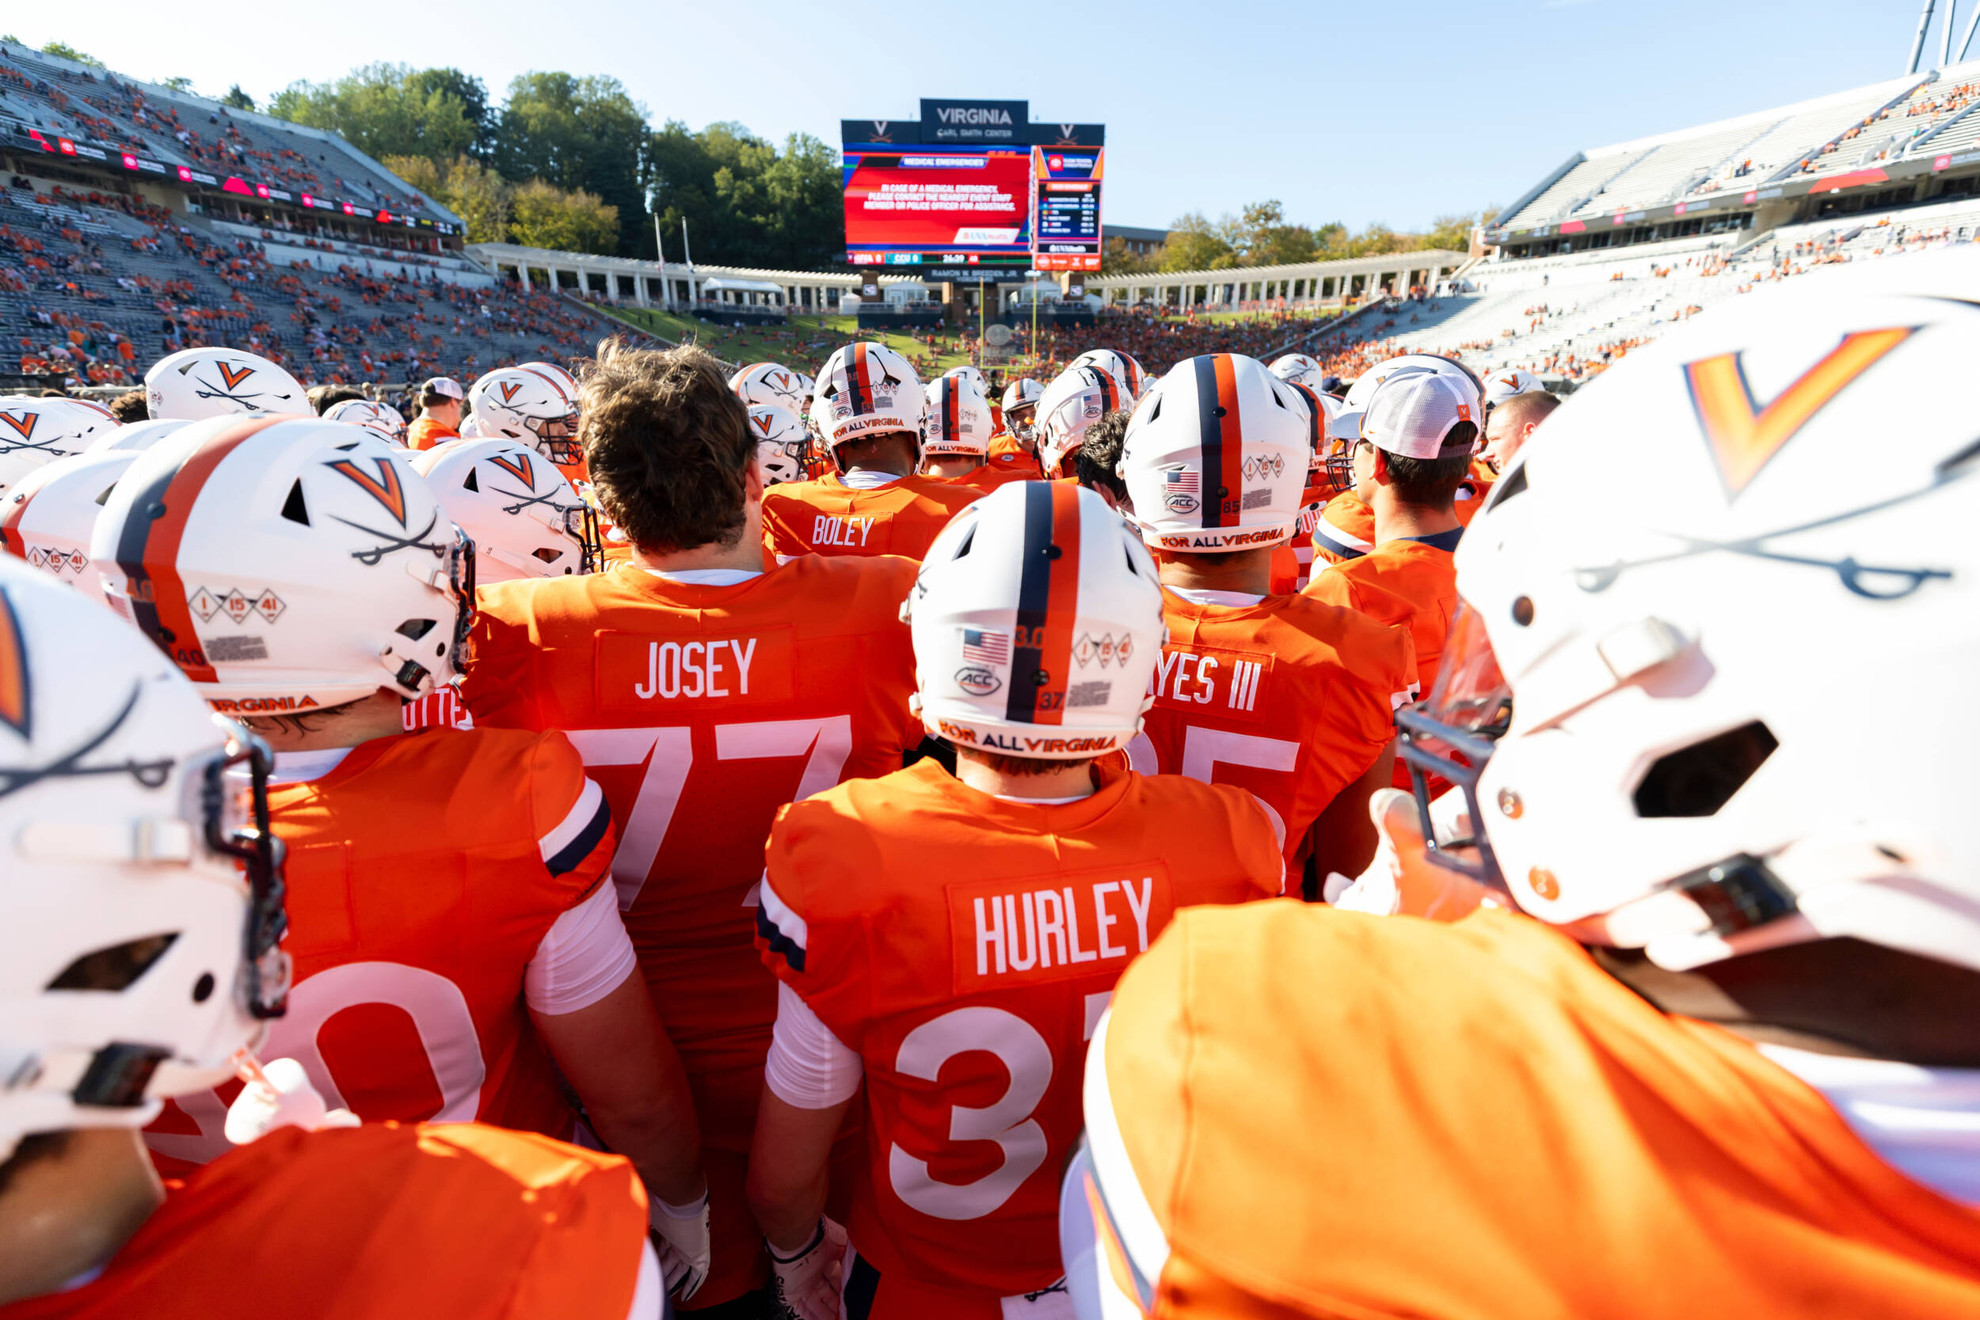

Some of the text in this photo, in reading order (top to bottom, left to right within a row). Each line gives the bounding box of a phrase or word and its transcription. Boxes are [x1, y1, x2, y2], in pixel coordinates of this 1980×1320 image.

[936, 108, 1013, 125] VIRGINIA
[936, 128, 1013, 138] CARL SMITH CENTER
[904, 157, 985, 167] MEDICAL EMERGENCIES
[868, 192, 894, 201] PLEASE
[894, 192, 925, 201] CONTACT
[925, 193, 939, 201] THE
[890, 184, 909, 193] CASE
[924, 184, 955, 193] MEDICAL
[863, 200, 895, 210] MEMBER
[906, 201, 931, 210] POLICE
[959, 202, 974, 211] FOR
[832, 417, 905, 439] FOR ALL VIRGINIA
[1222, 500, 1241, 514] 85
[811, 514, 876, 548] BOLEY
[1160, 528, 1285, 548] FOR ALL VIRGINIA
[229, 597, 246, 611] 15
[261, 598, 277, 611] 41
[634, 637, 757, 700] JOSEY
[961, 673, 993, 686] ACC
[1039, 691, 1065, 710] 37
[938, 719, 1117, 753] FOR ALL VIRGINIA
[562, 714, 852, 912] 77
[973, 877, 1153, 976] HURLEY
